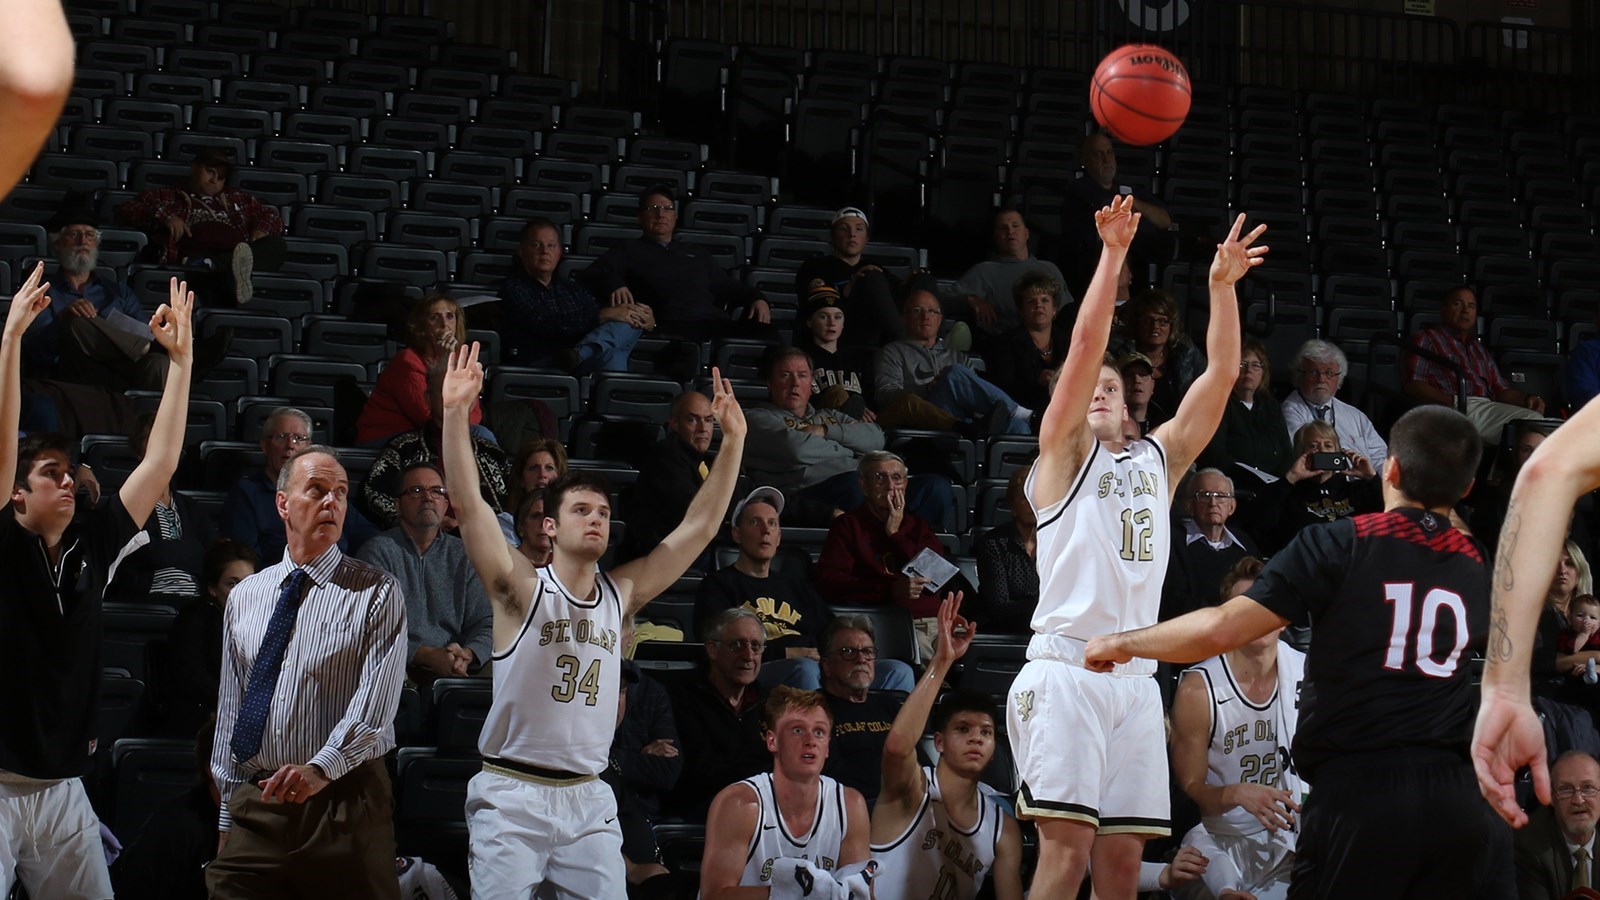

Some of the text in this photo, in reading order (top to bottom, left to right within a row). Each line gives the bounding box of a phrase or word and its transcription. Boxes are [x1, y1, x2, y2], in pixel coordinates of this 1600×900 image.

[1097, 471, 1126, 499] S.
[1119, 507, 1154, 562] 12
[538, 618, 617, 655] ST. OLAF
[1382, 581, 1470, 678] 10
[551, 654, 601, 707] 34
[867, 720, 893, 733] COLL
[1224, 719, 1278, 756] ST. OL
[1240, 753, 1279, 789] 22
